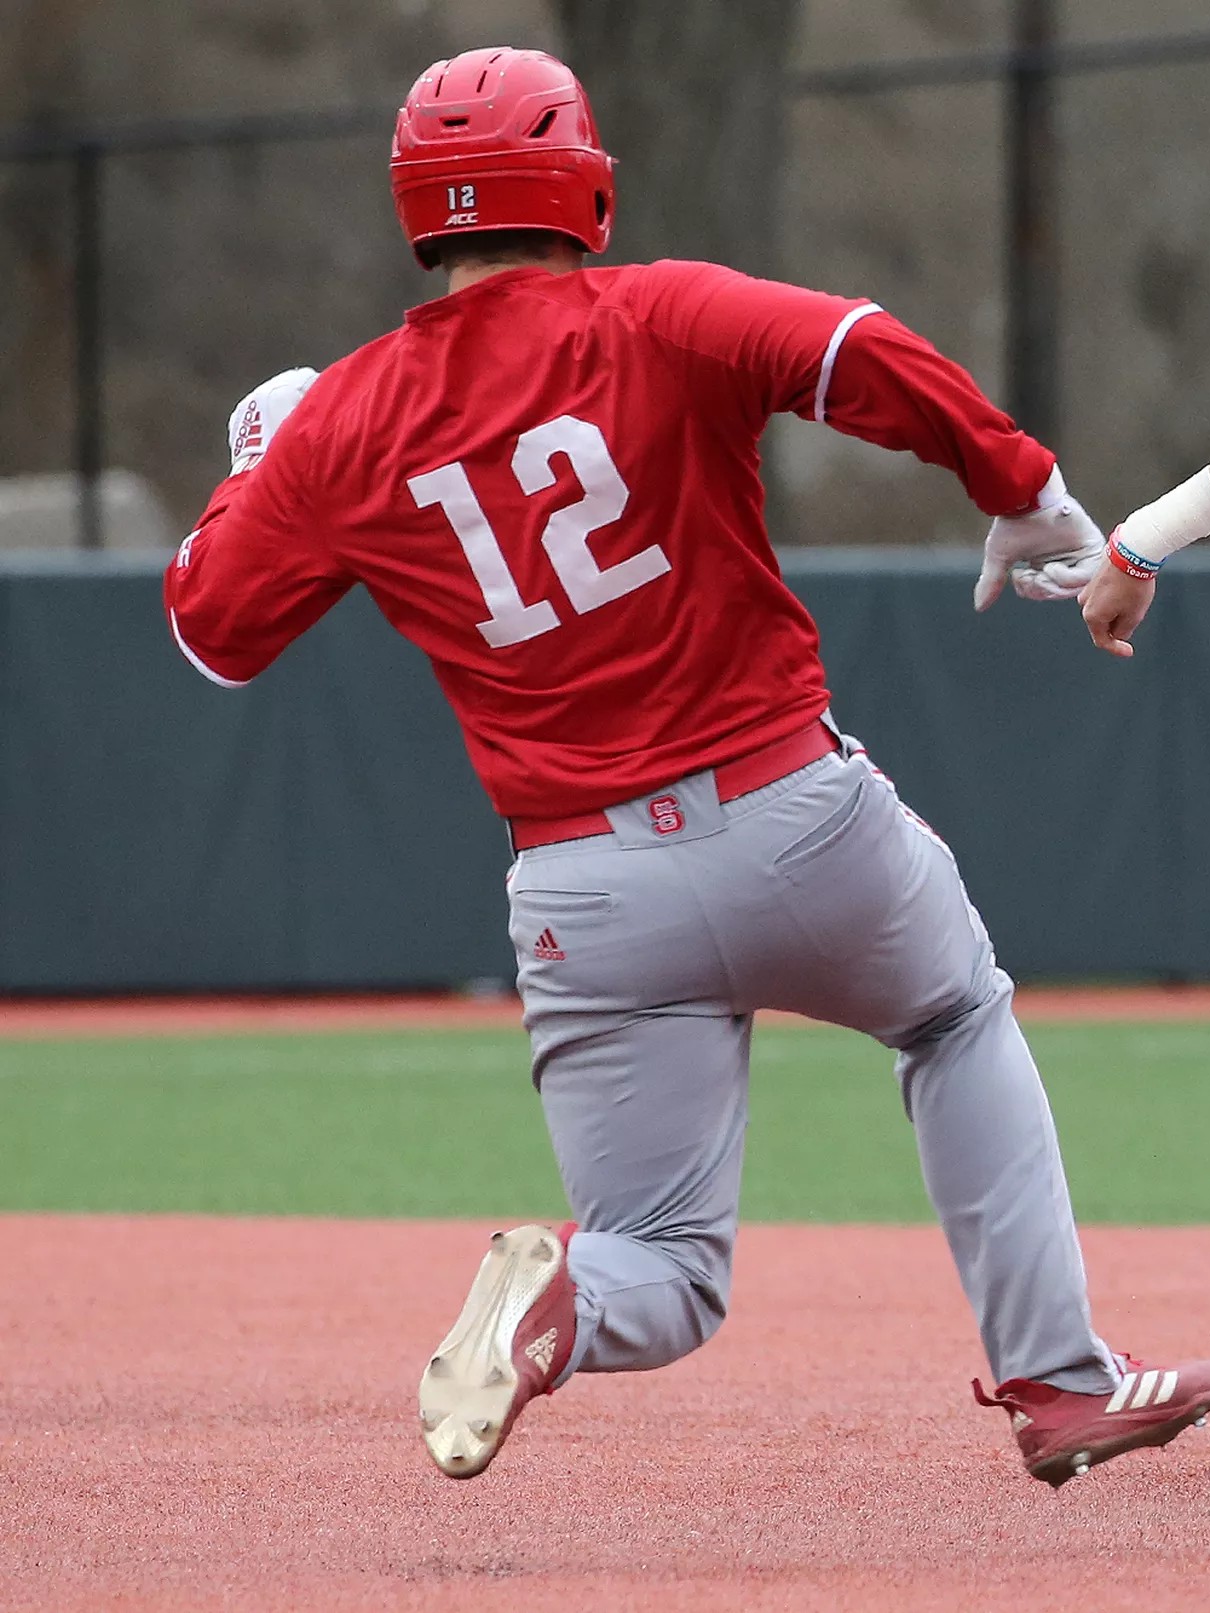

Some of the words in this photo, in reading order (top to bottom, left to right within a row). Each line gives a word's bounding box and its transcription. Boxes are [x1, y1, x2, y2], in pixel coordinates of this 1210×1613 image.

[447, 184, 475, 210] 12
[444, 212, 479, 226] ACC
[234, 400, 258, 457] adidas
[406, 414, 672, 649] 12
[1126, 565, 1149, 579] Team
